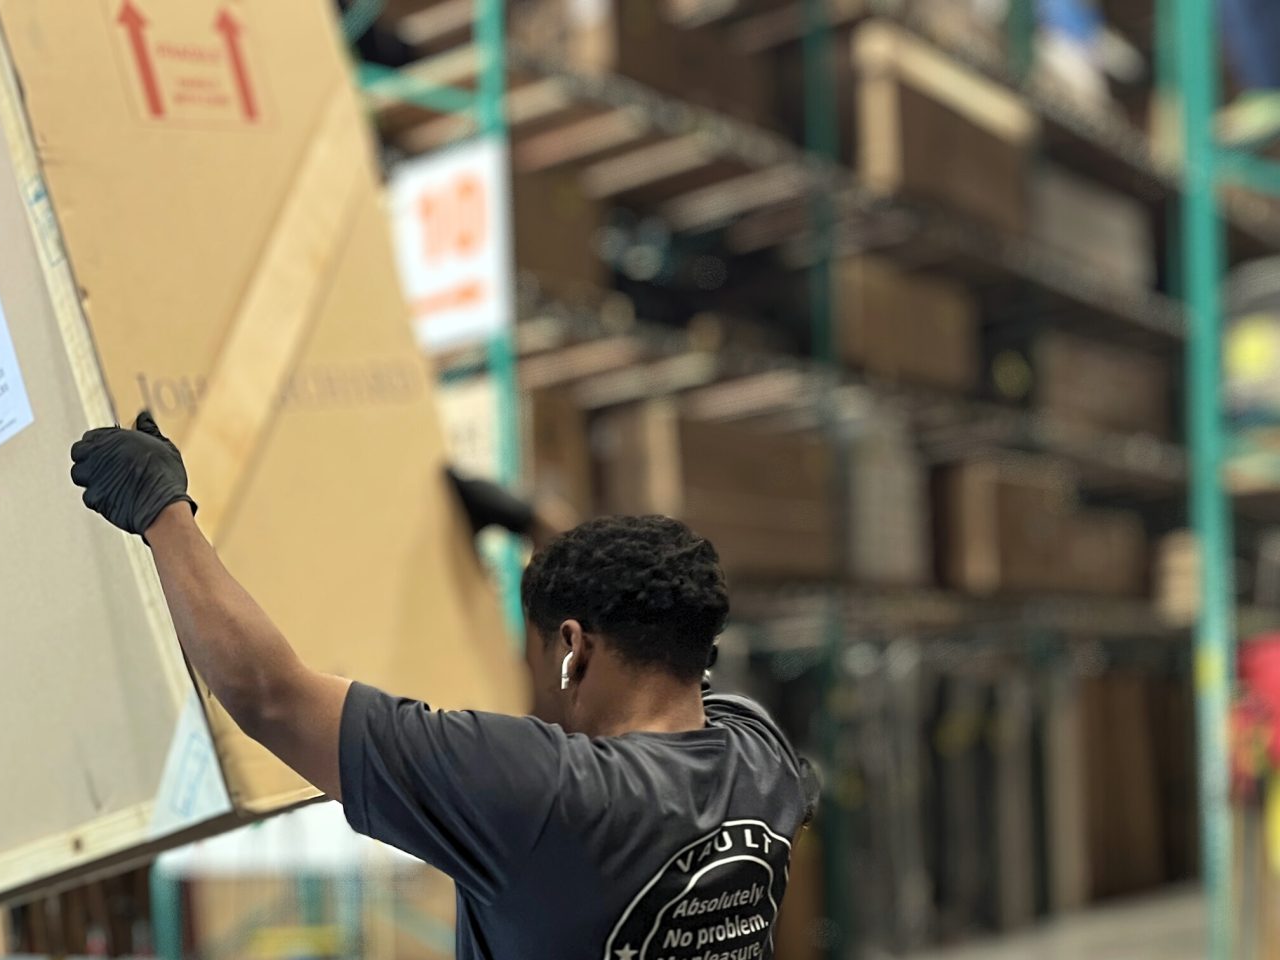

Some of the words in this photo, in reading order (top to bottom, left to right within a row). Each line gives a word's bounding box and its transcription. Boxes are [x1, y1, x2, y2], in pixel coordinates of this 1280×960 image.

[415, 173, 489, 265] 10
[676, 829, 772, 873] VAULT
[663, 928, 693, 949] No
[696, 913, 769, 950] problem.
